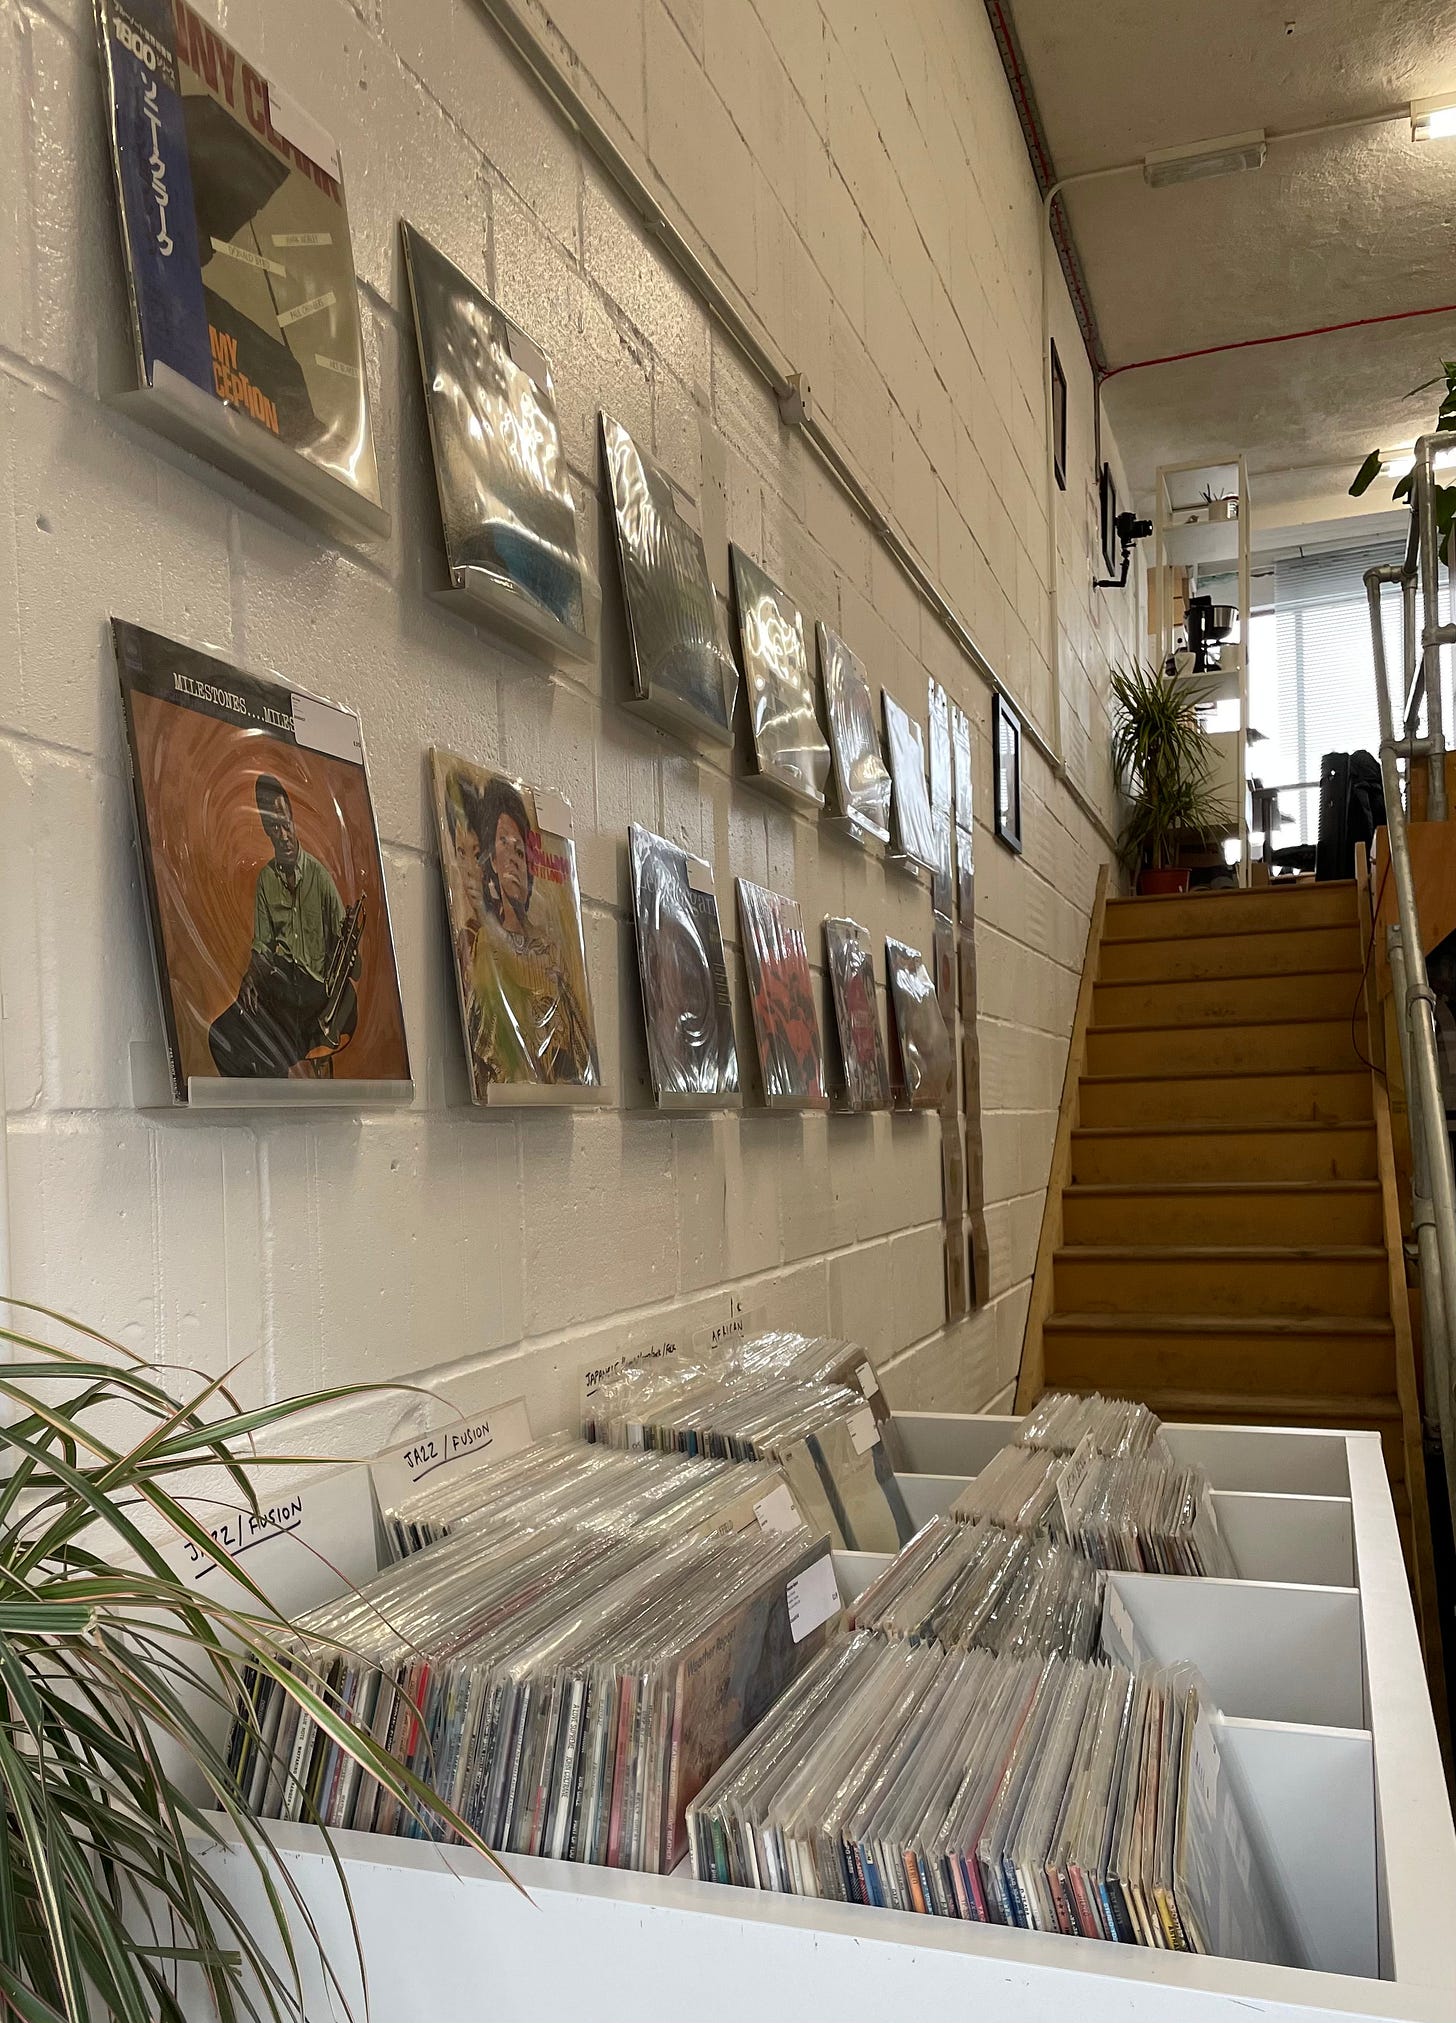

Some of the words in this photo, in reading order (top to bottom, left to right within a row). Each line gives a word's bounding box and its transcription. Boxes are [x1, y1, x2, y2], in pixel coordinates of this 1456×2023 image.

[112, 17, 157, 72] 1800
[208, 323, 238, 371] MY
[451, 1421, 490, 1452] FUSION
[183, 1525, 236, 1562] JZ
[567, 1723, 577, 1750] SUPREME
[561, 1770, 572, 1799] COLTRANE
